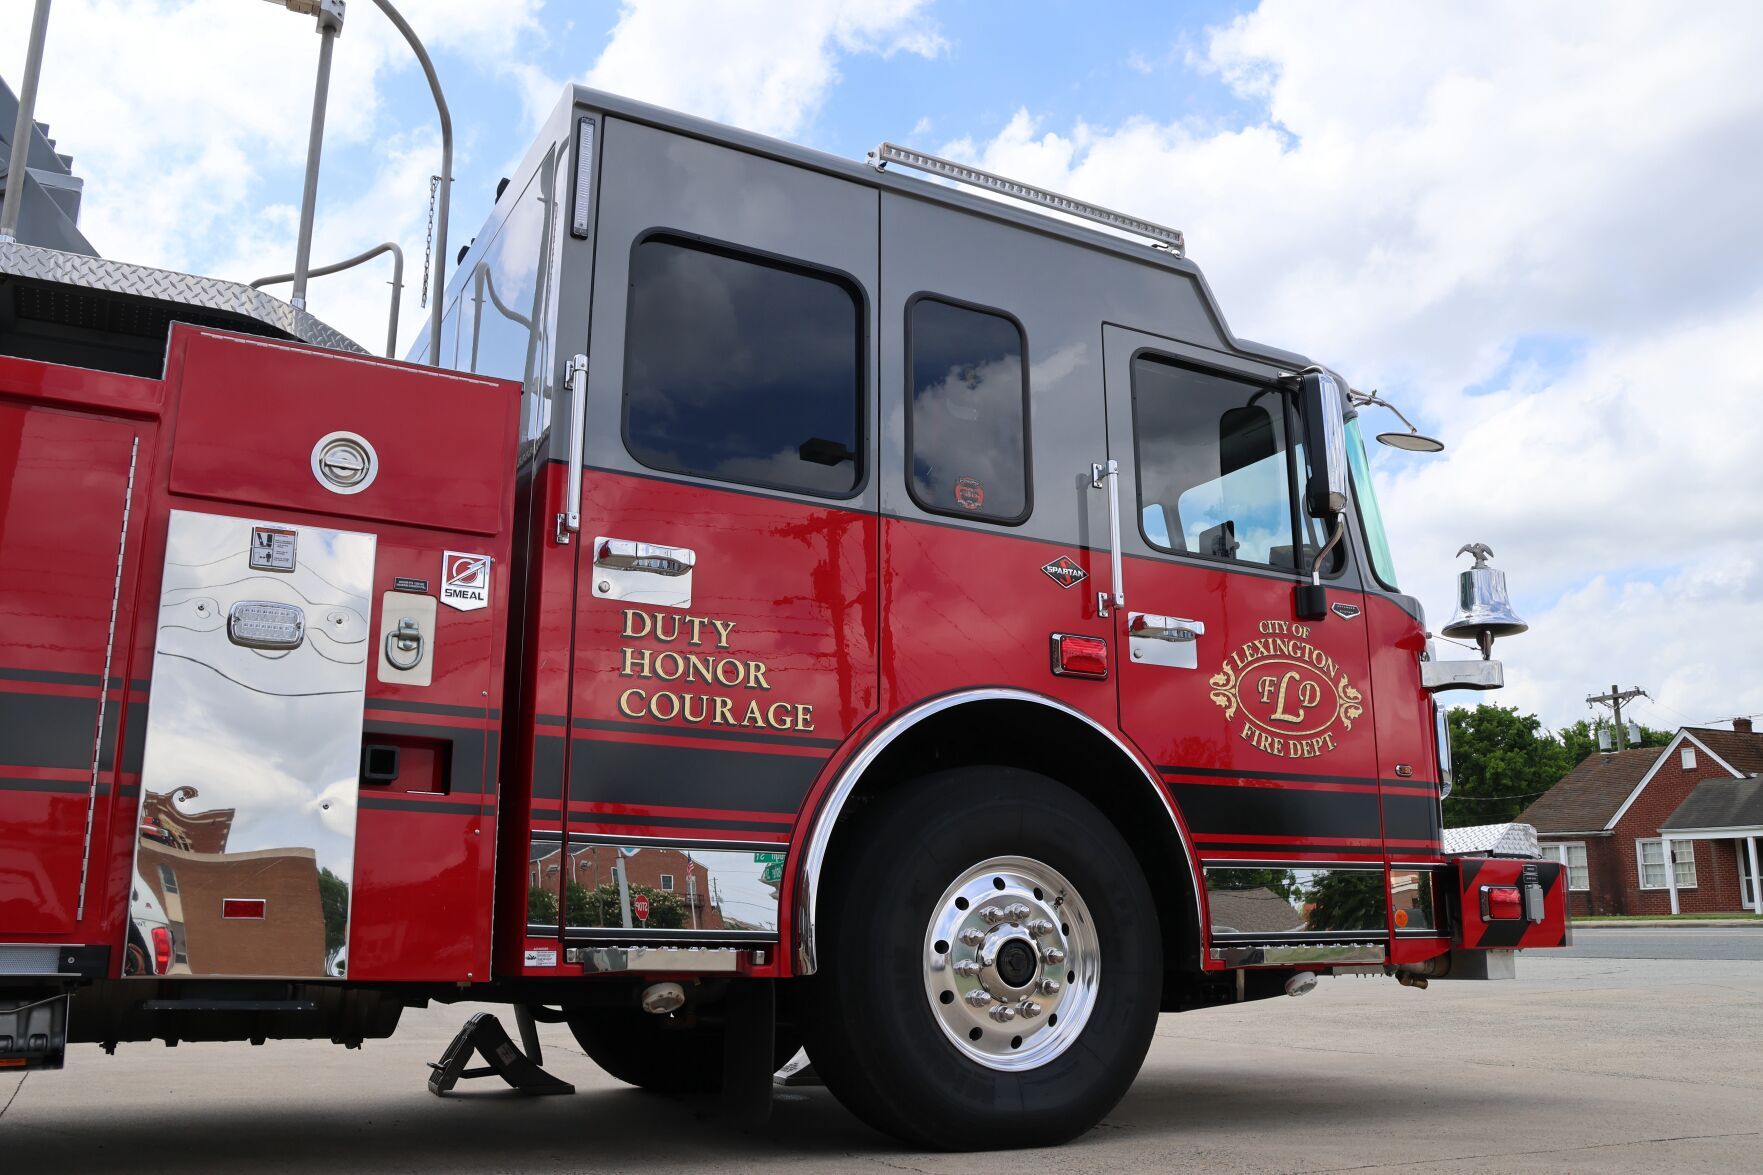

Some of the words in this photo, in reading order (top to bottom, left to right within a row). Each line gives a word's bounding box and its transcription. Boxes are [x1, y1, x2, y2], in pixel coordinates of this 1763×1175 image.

[1046, 566, 1083, 577] SPARTAN
[444, 589, 484, 601] SMEAL
[621, 609, 736, 647] DUTY
[1259, 620, 1289, 634] CITY
[1292, 624, 1310, 638] OF
[619, 647, 770, 689] HONOR
[1231, 638, 1339, 678] LEXINGTON
[618, 688, 815, 732] COURAGE
[1240, 722, 1284, 757] FIRE
